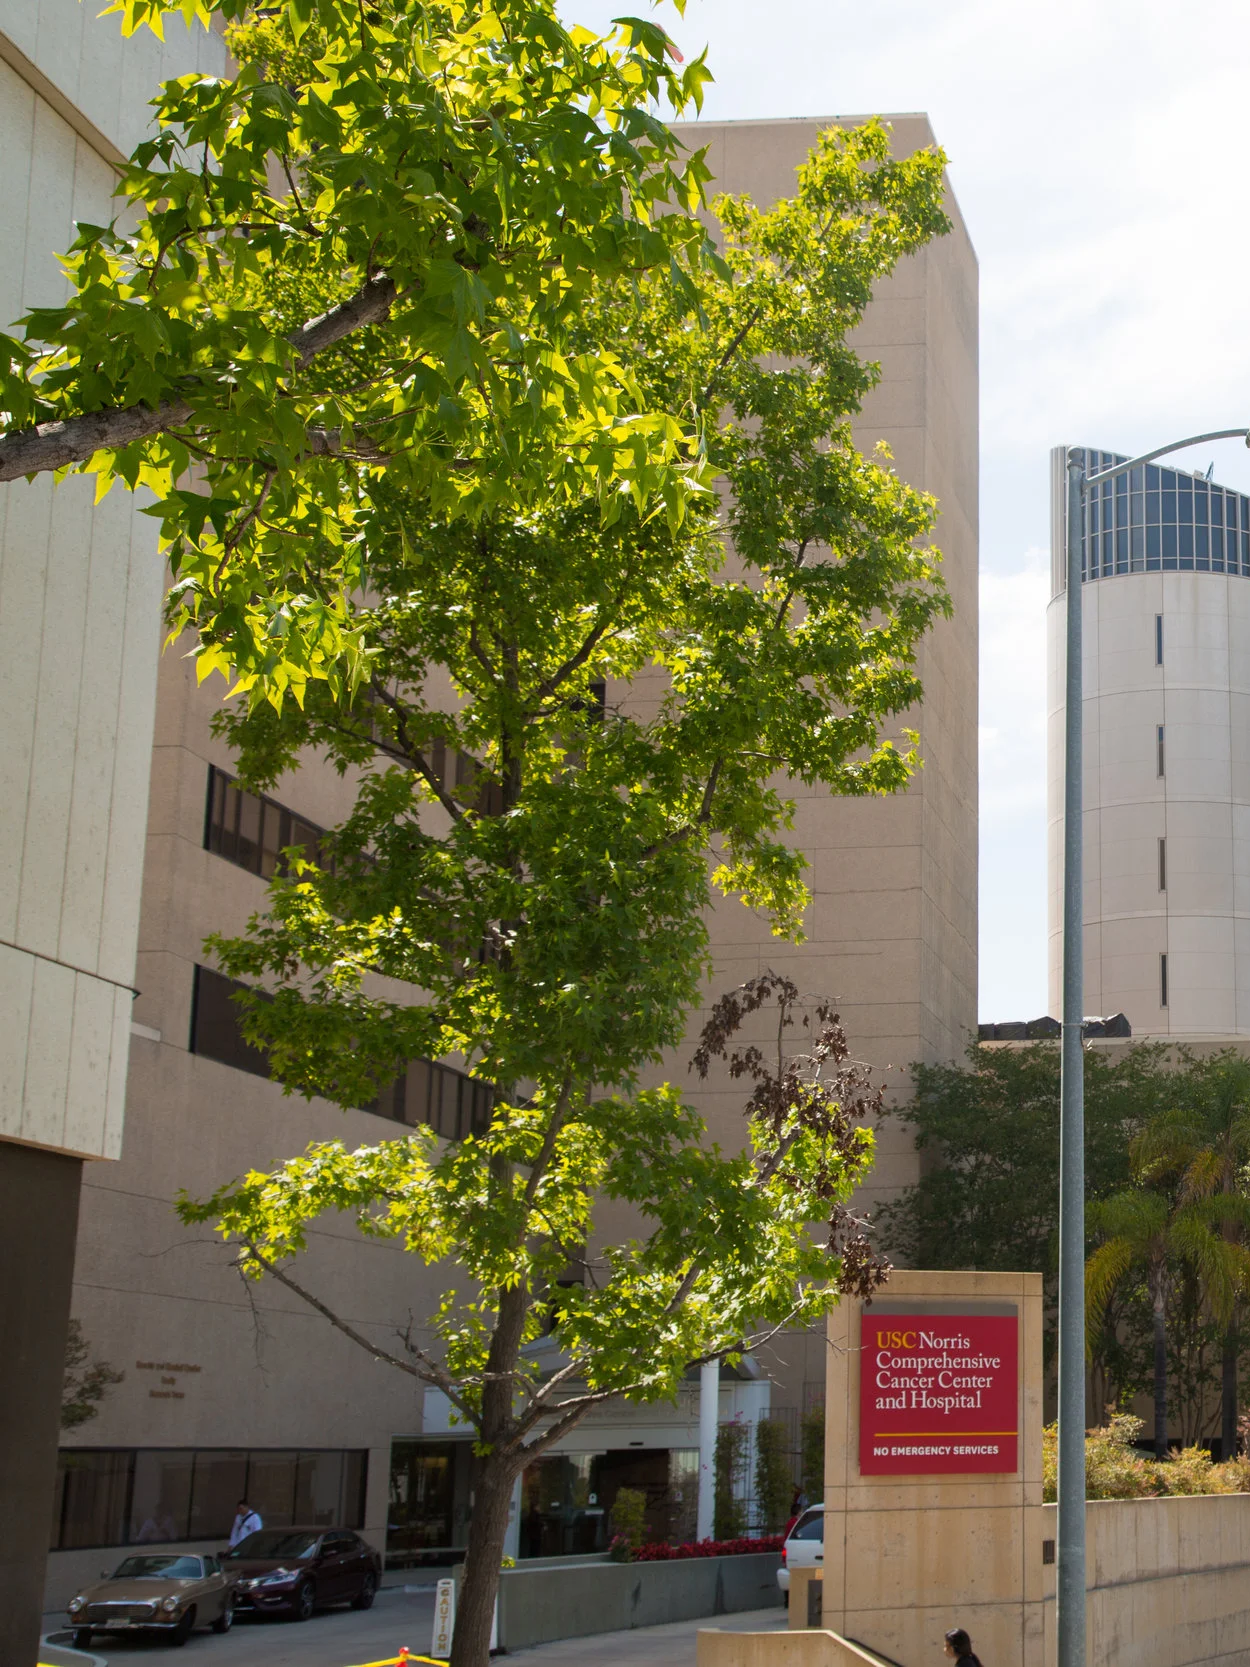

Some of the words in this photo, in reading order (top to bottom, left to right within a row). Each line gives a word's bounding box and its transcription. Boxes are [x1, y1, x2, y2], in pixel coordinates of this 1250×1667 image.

[876, 1331, 917, 1349] USC
[918, 1331, 970, 1349] Norris
[876, 1351, 1001, 1374] Comprehensive
[876, 1371, 935, 1389] Cancer
[938, 1371, 993, 1389] Center
[875, 1391, 907, 1410] and
[910, 1390, 982, 1414] Hospital
[873, 1447, 889, 1456] NO
[891, 1446, 951, 1455] EMERGENCY
[953, 1445, 999, 1455] SERVICES
[437, 1588, 450, 1651] CAUTION
